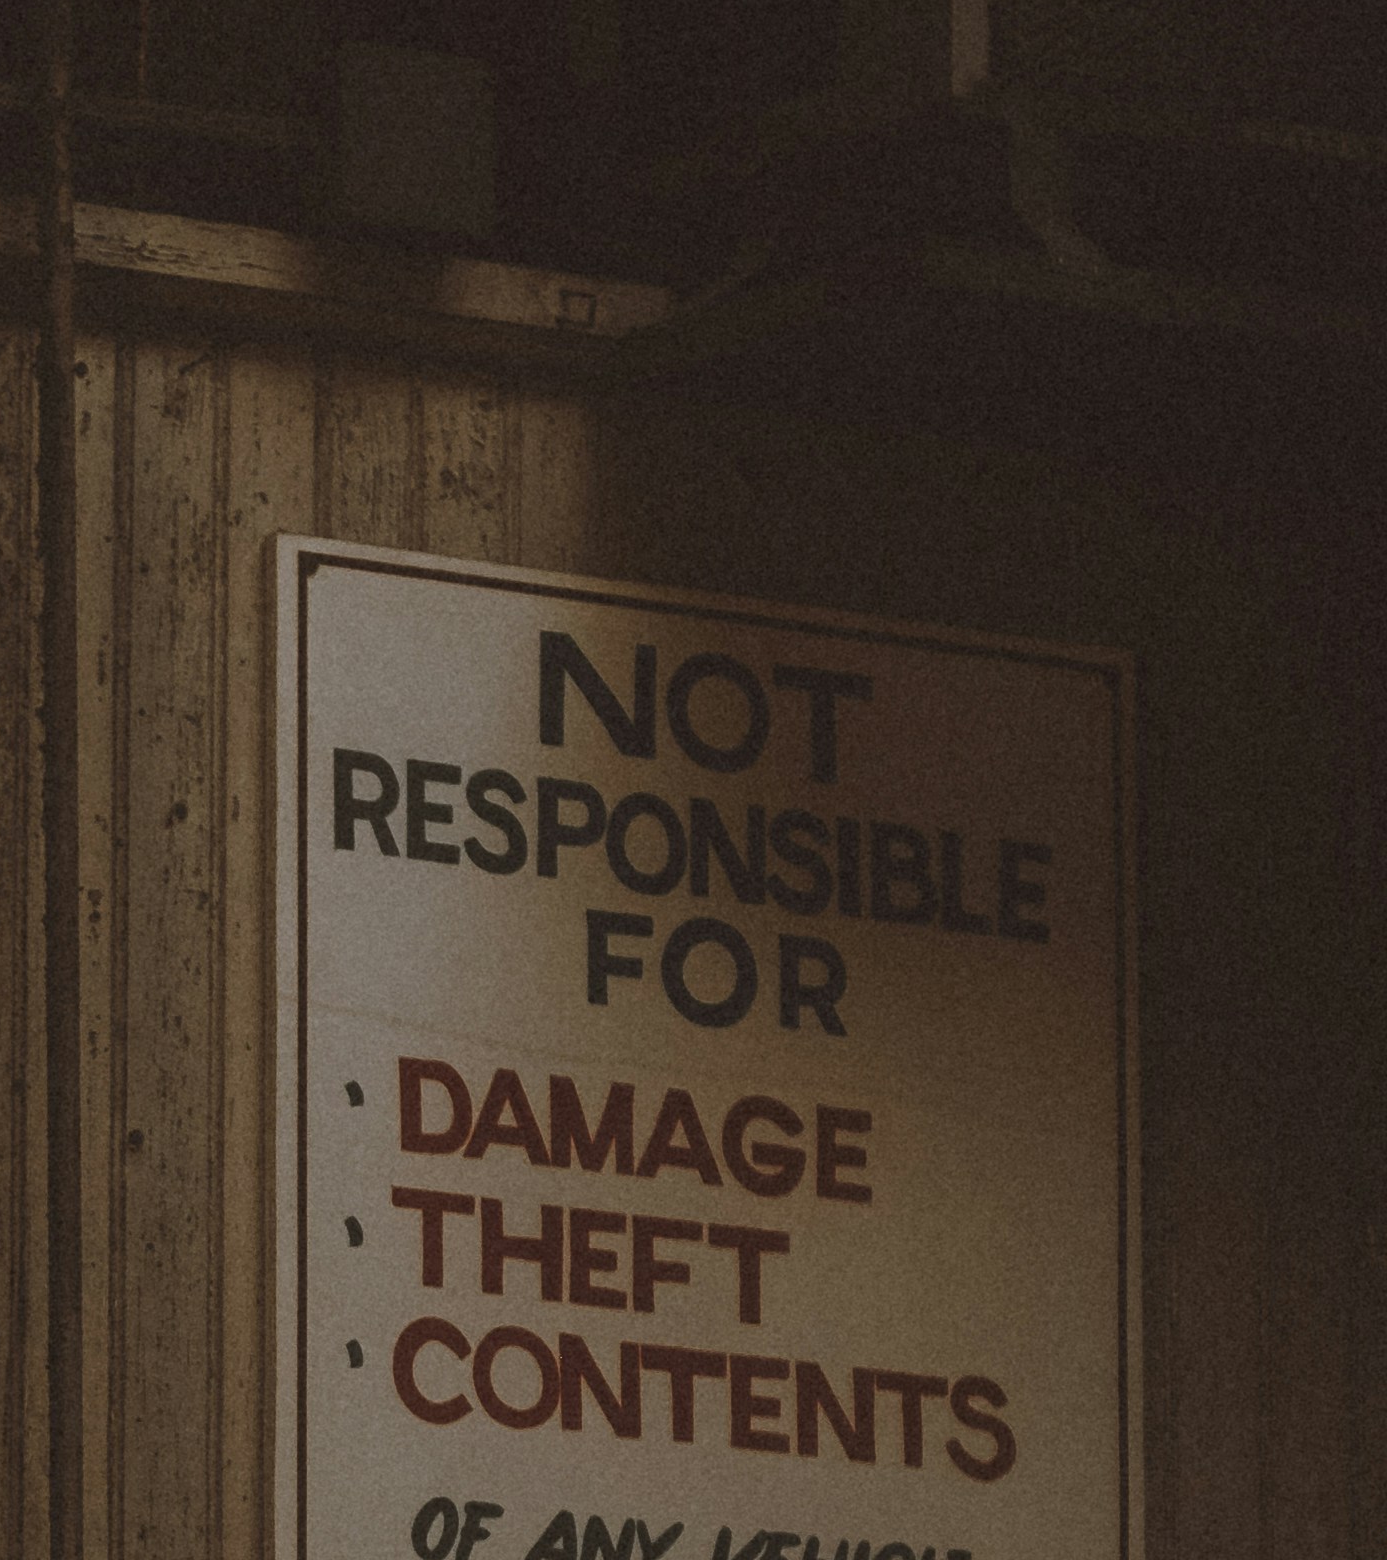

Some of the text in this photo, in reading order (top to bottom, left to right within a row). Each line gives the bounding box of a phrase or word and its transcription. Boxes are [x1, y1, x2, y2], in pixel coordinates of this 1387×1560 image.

[537, 630, 872, 789] NOT
[330, 748, 1054, 945] RESPONSIBLE
[585, 908, 848, 1037] FOR
[396, 1056, 874, 1204] DAMAGE
[391, 1185, 791, 1326] THEFT
[391, 1318, 1017, 1483] CONTENTS
